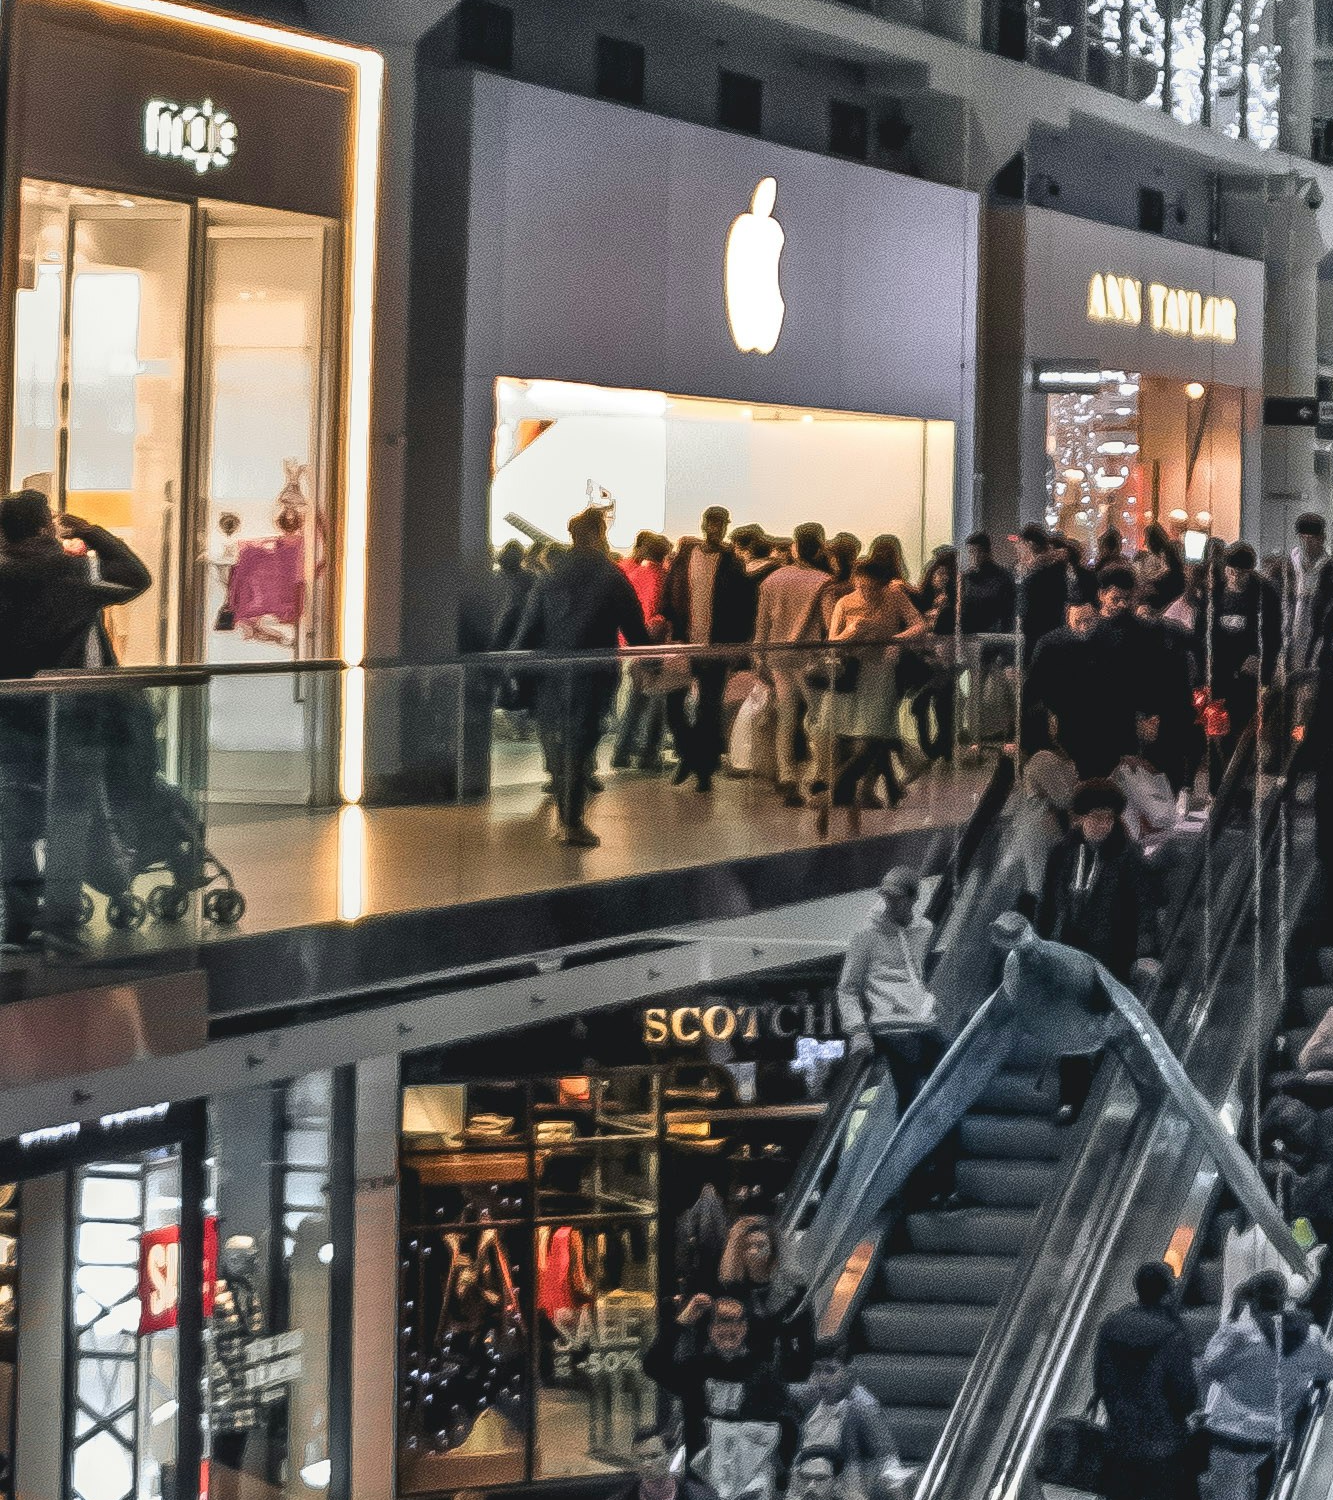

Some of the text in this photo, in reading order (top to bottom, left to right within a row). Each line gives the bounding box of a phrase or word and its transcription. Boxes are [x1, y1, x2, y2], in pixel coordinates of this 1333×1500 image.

[1088, 272, 1237, 342] ANN TAYLOR
[643, 1002, 838, 1043] SCOTCH
